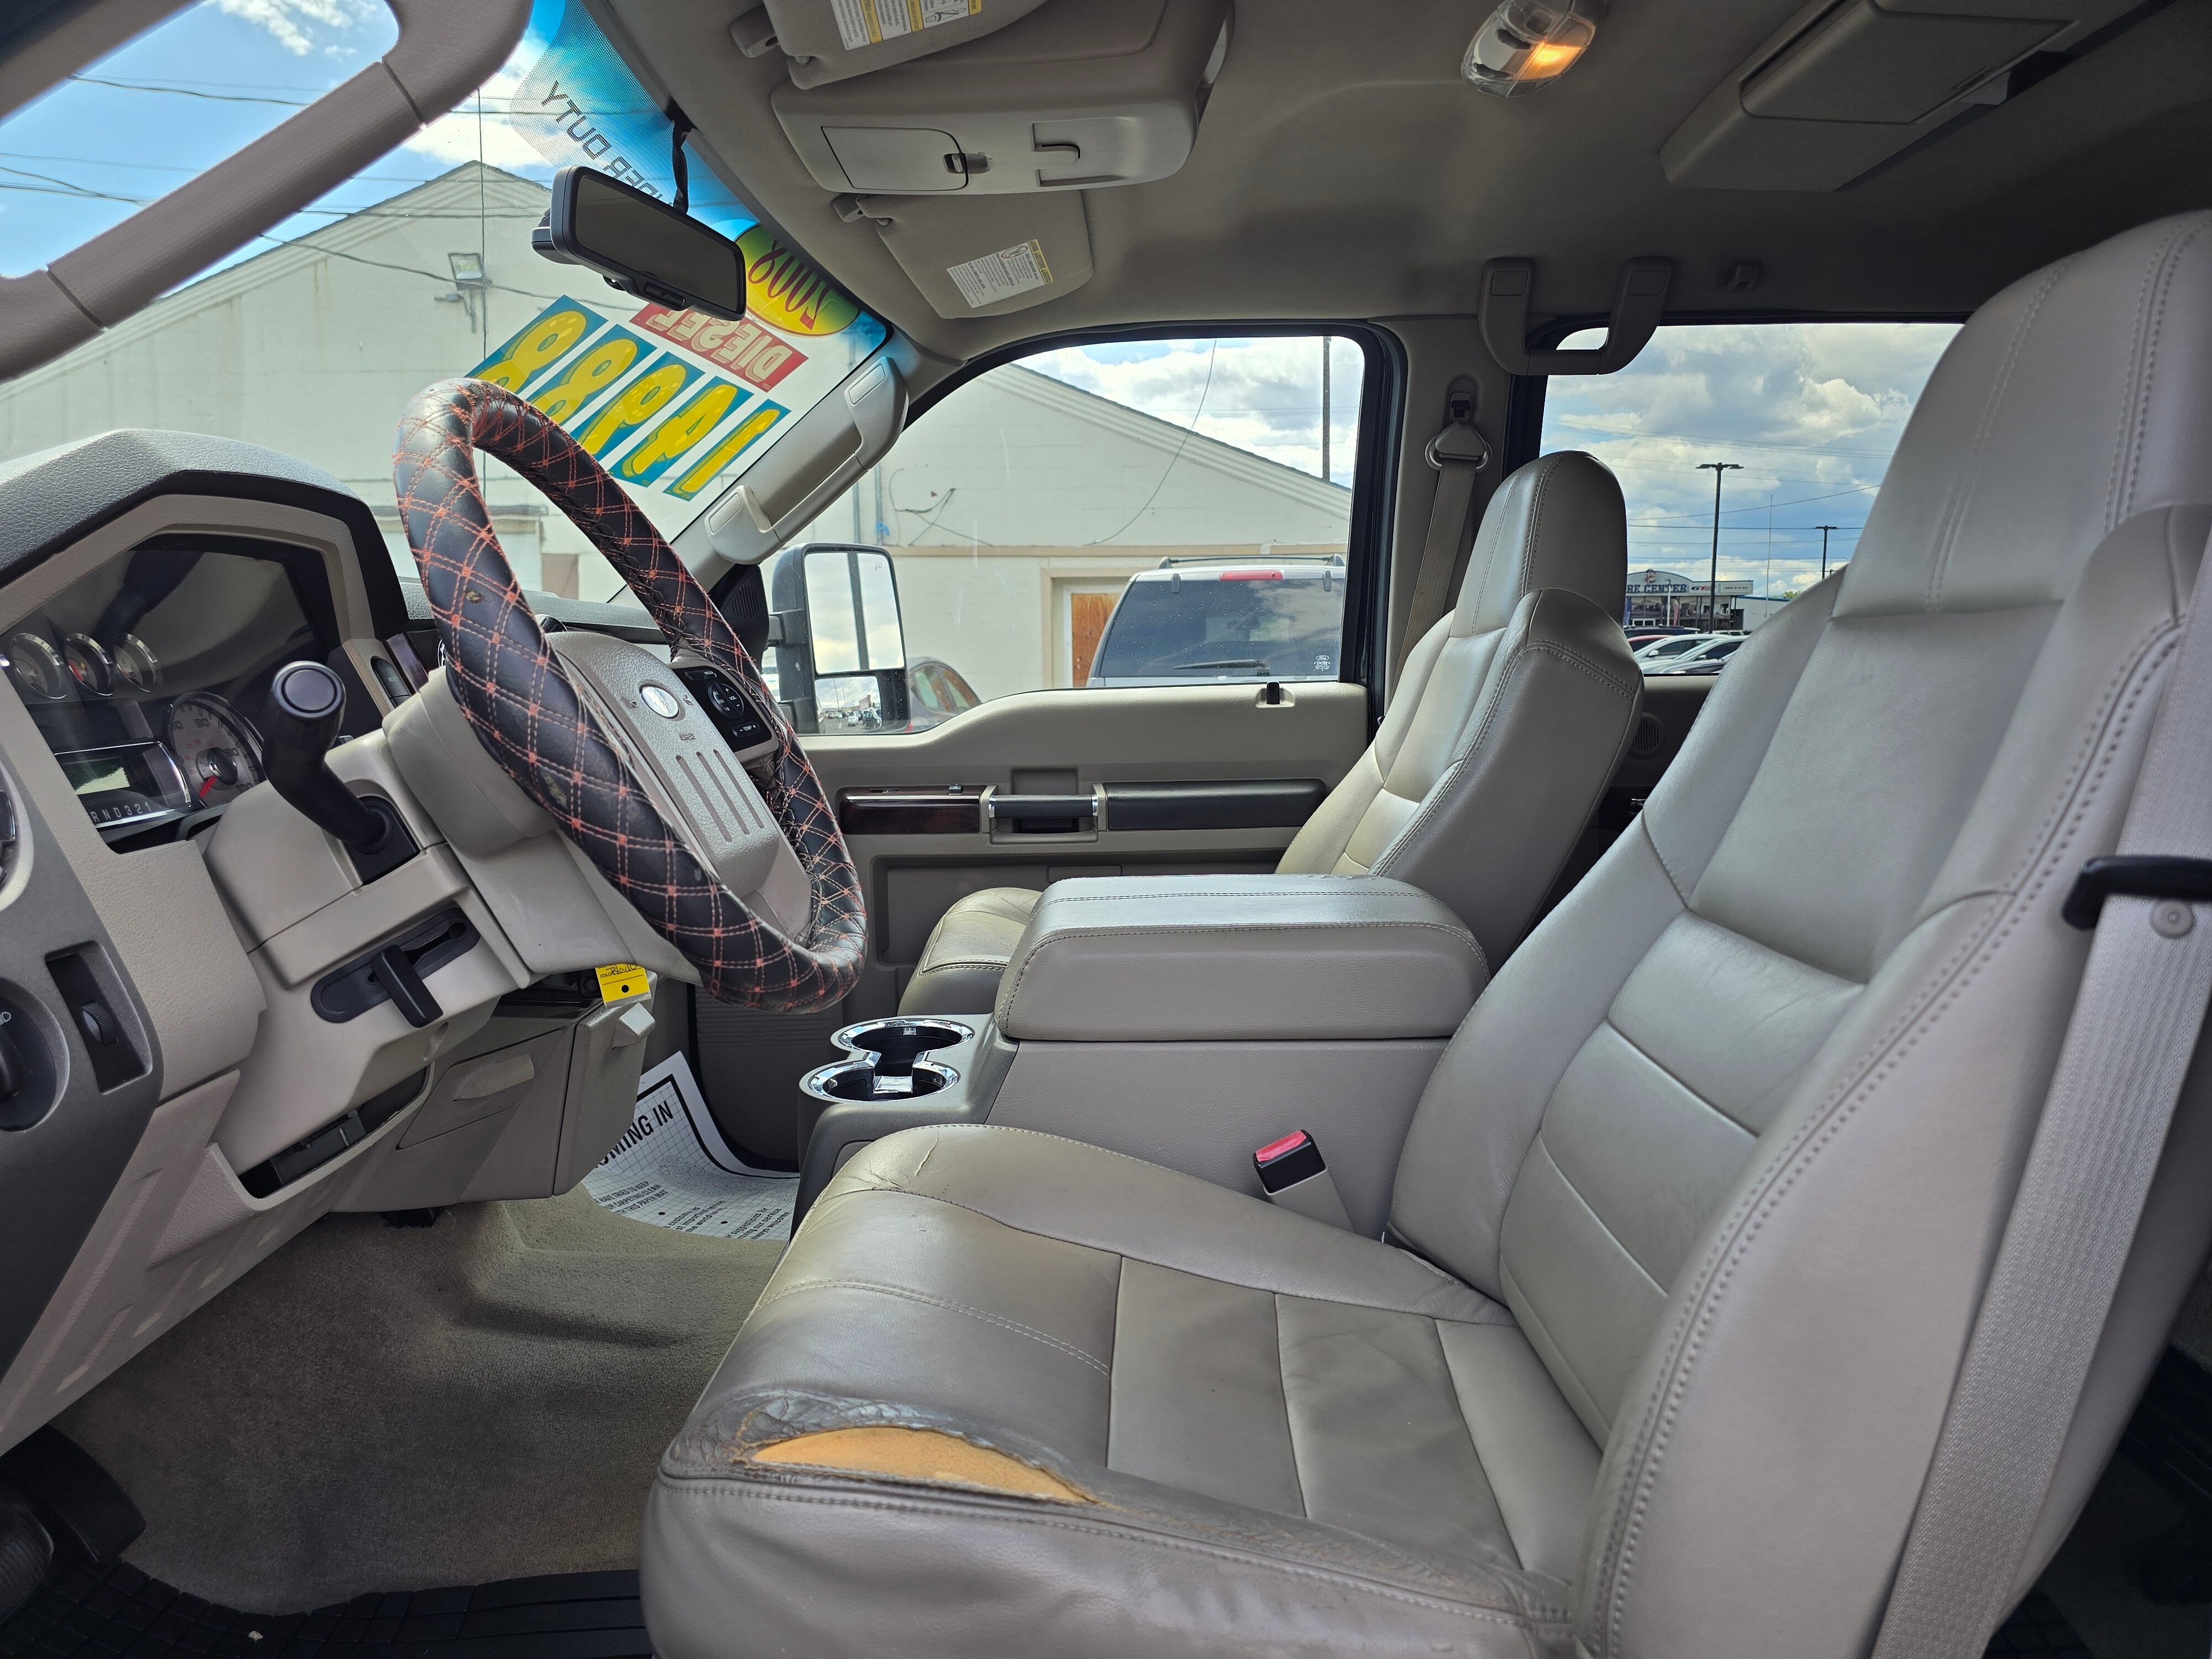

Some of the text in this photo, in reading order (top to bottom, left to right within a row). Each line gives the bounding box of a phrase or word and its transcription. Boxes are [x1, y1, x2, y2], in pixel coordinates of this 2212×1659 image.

[1627, 584, 1687, 593] RE CENTER
[90, 802, 152, 822] R N D 3 2 1
[653, 1100, 674, 1126] IN
[598, 1194, 615, 1203] HAVE
[612, 1190, 630, 1198] TRIED
[635, 1181, 650, 1190] KEEP
[641, 1184, 662, 1194] CLEAN
[626, 1203, 640, 1212] THIS
[638, 1196, 658, 1207] PAPER
[653, 1190, 669, 1198] MAT
